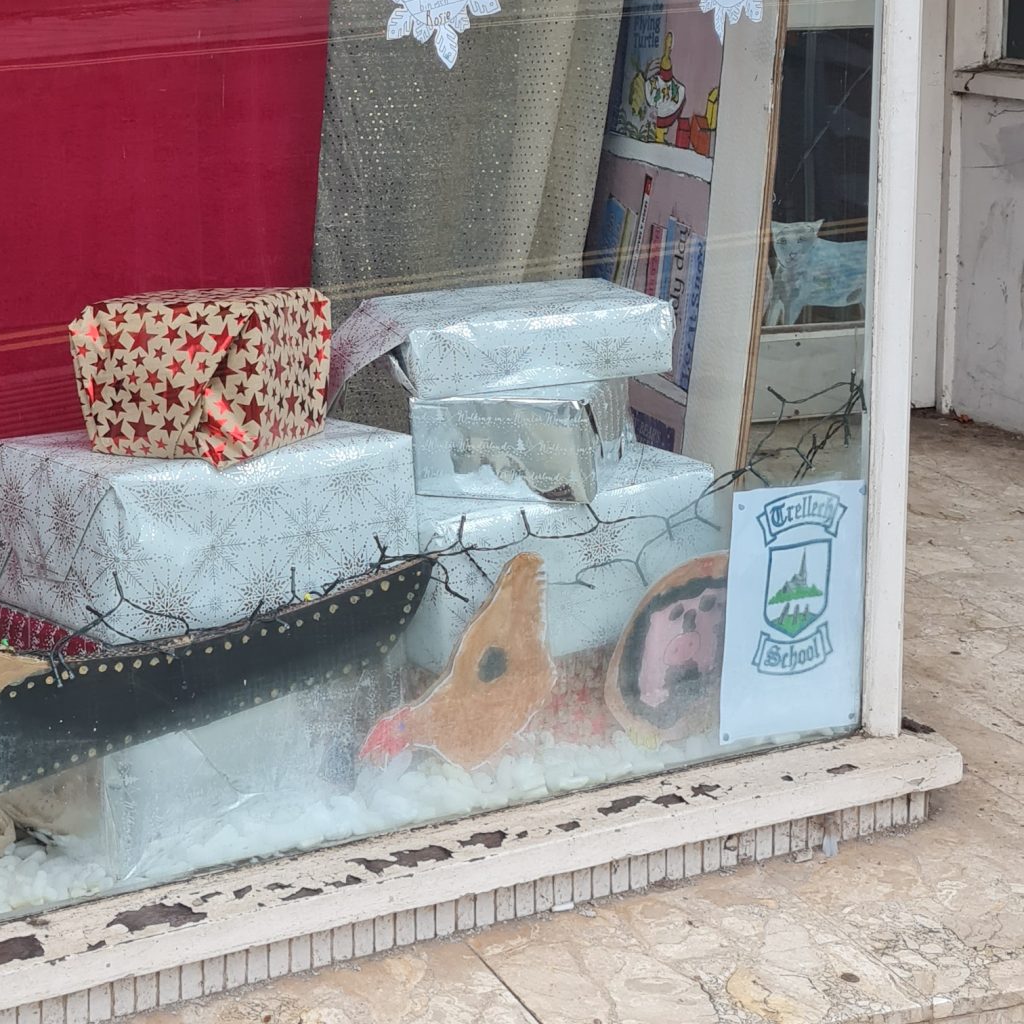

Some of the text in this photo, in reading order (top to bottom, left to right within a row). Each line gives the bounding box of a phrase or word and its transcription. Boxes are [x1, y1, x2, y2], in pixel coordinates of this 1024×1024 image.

[633, 32, 660, 49] Turtle
[674, 222, 690, 271] day
[690, 241, 704, 308] Snow
[770, 495, 838, 527] Trellech
[764, 636, 821, 671] School
